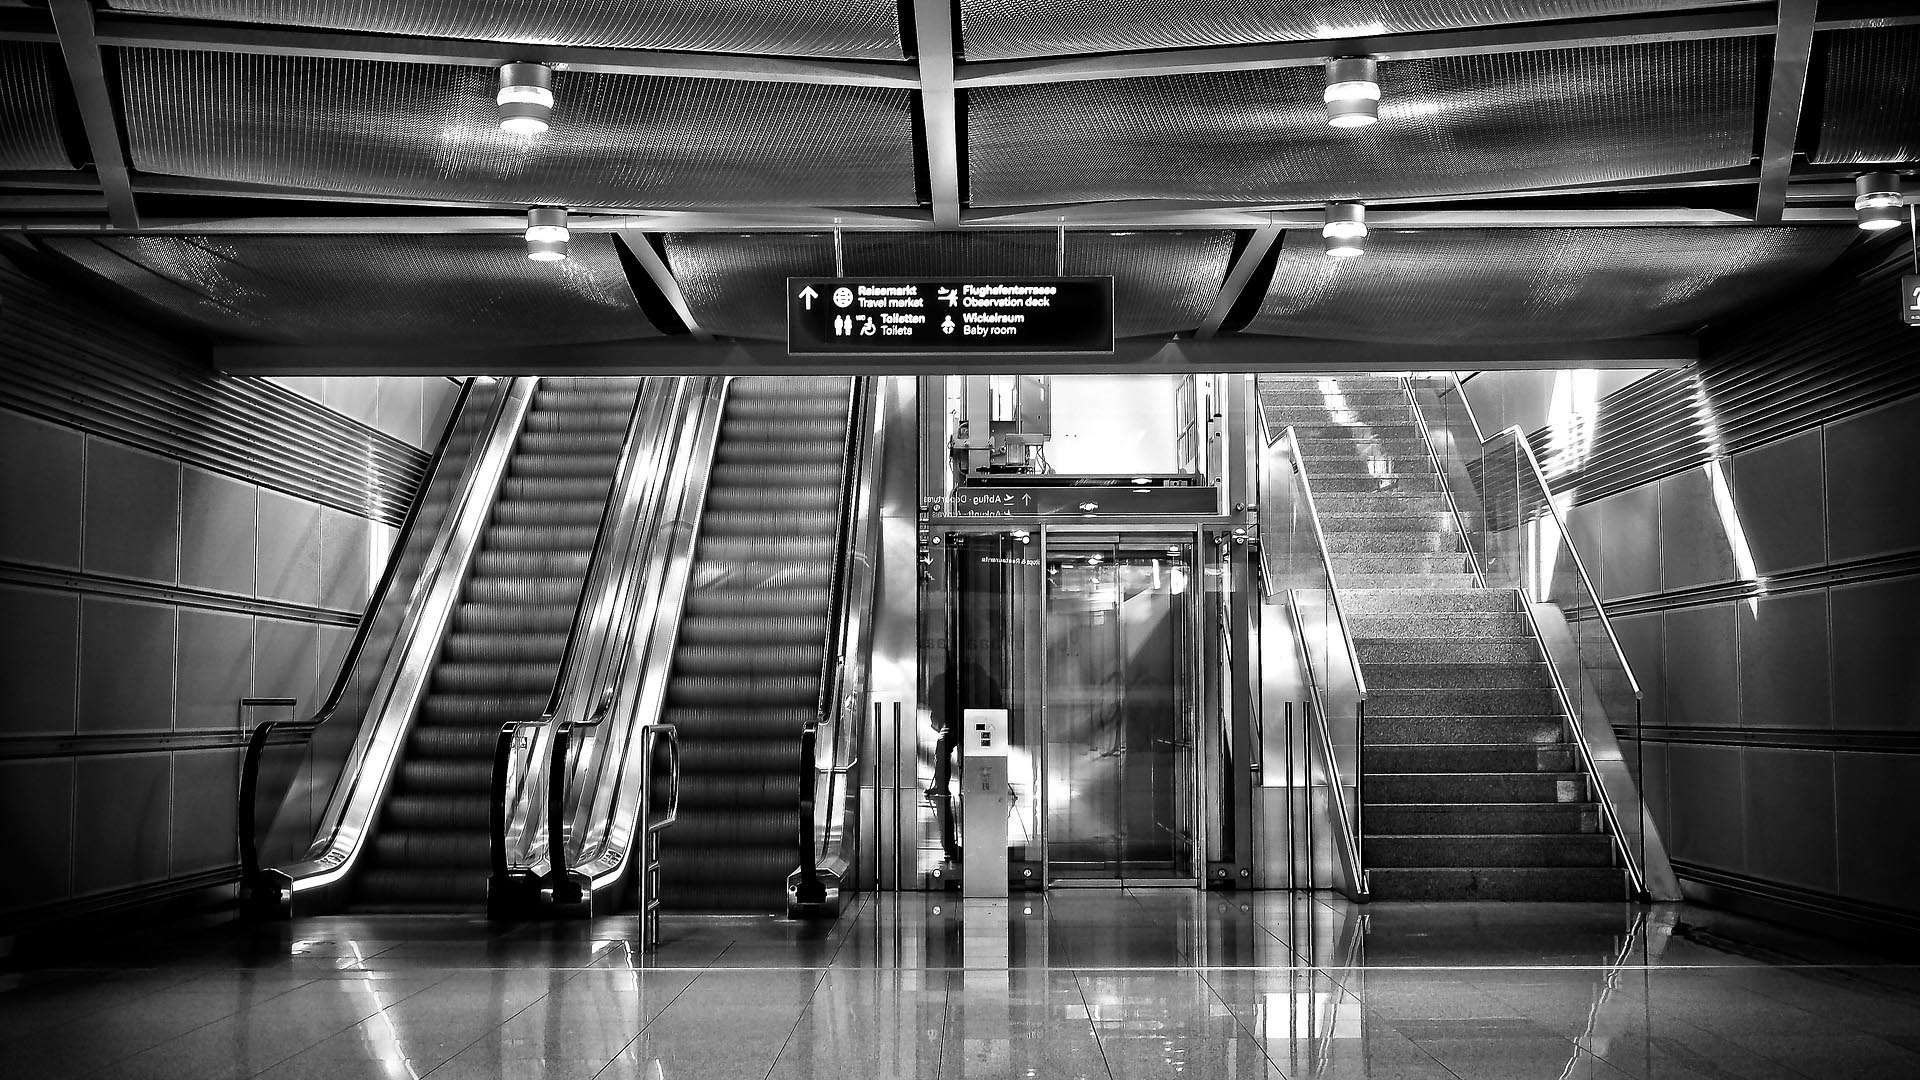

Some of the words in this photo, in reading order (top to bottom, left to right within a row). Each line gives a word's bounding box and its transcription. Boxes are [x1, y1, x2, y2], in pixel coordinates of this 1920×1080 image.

[858, 285, 917, 296] Reisemarkt
[858, 297, 887, 308] Travel
[888, 297, 924, 308] market
[962, 296, 1023, 307] Observation
[1025, 296, 1050, 307] deck
[880, 312, 925, 324] Toiletten
[962, 312, 1025, 323] Wickelraum
[880, 325, 913, 336] Toilets
[963, 325, 989, 337] Baby
[990, 326, 1017, 335] room
